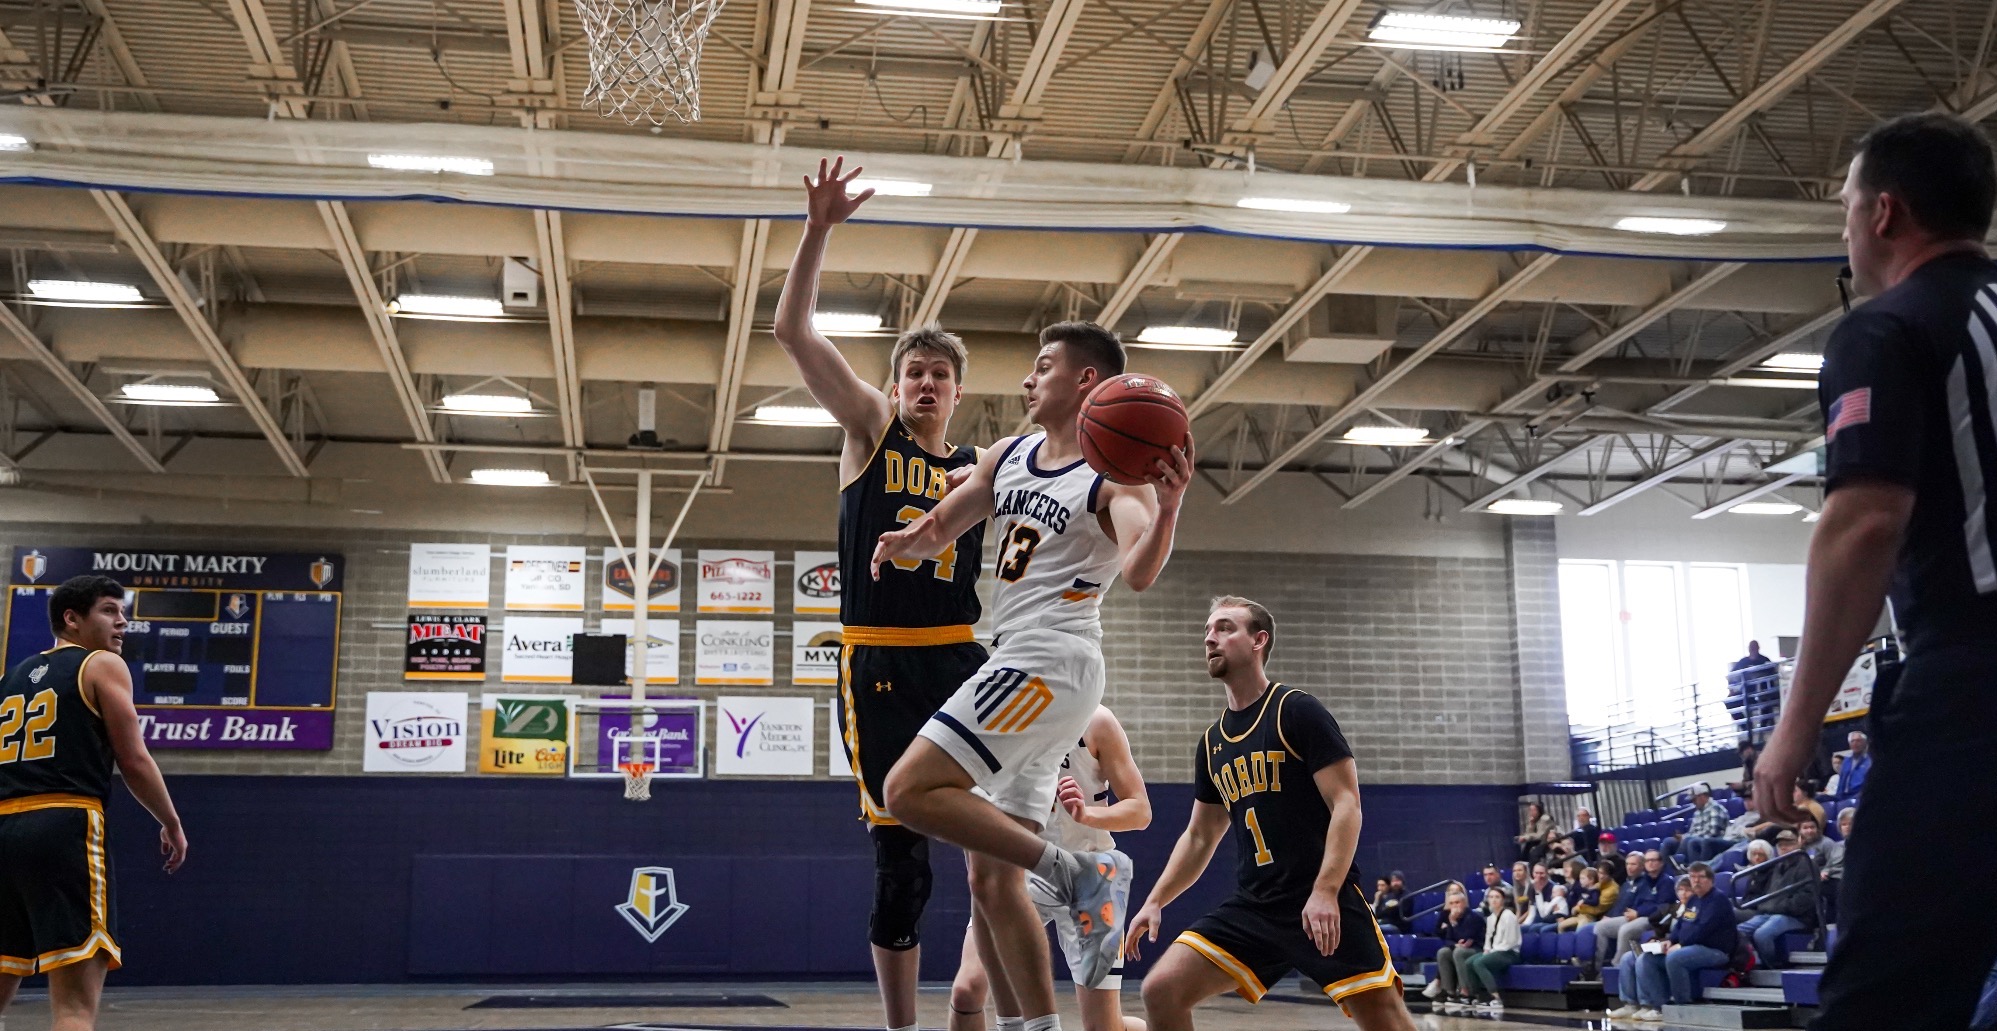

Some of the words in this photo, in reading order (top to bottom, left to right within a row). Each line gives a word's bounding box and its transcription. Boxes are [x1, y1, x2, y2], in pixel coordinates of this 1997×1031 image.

[885, 449, 947, 501] DOR
[994, 489, 1071, 535] LANCERS
[995, 521, 1042, 585] 13
[92, 552, 180, 572] MOUNT
[183, 554, 267, 574] MARTY
[412, 566, 486, 577] slumberland
[806, 567, 841, 592] KYN
[132, 575, 224, 587] UNIVERSITY
[710, 591, 762, 601] 665-1222
[159, 627, 190, 637] PERIOD
[209, 622, 250, 635] GUEST
[409, 623, 485, 644] MEAT
[507, 634, 562, 652] Avera
[701, 633, 770, 648] CONKLING
[143, 662, 175, 673] PLAYER
[177, 663, 200, 673] FOUL
[223, 664, 250, 674] FOULS
[0, 688, 58, 764] 22
[137, 714, 213, 741] Trust
[219, 716, 298, 742] Bank
[370, 718, 461, 739] Vision
[658, 727, 690, 741] Bank
[760, 721, 802, 731] YANKTON
[760, 731, 801, 741] MEDICAL
[494, 750, 525, 769] Lite
[535, 748, 566, 763] Coor
[537, 761, 564, 770] LIGH
[1213, 750, 1286, 812] DORDT
[1245, 806, 1275, 867] 1
